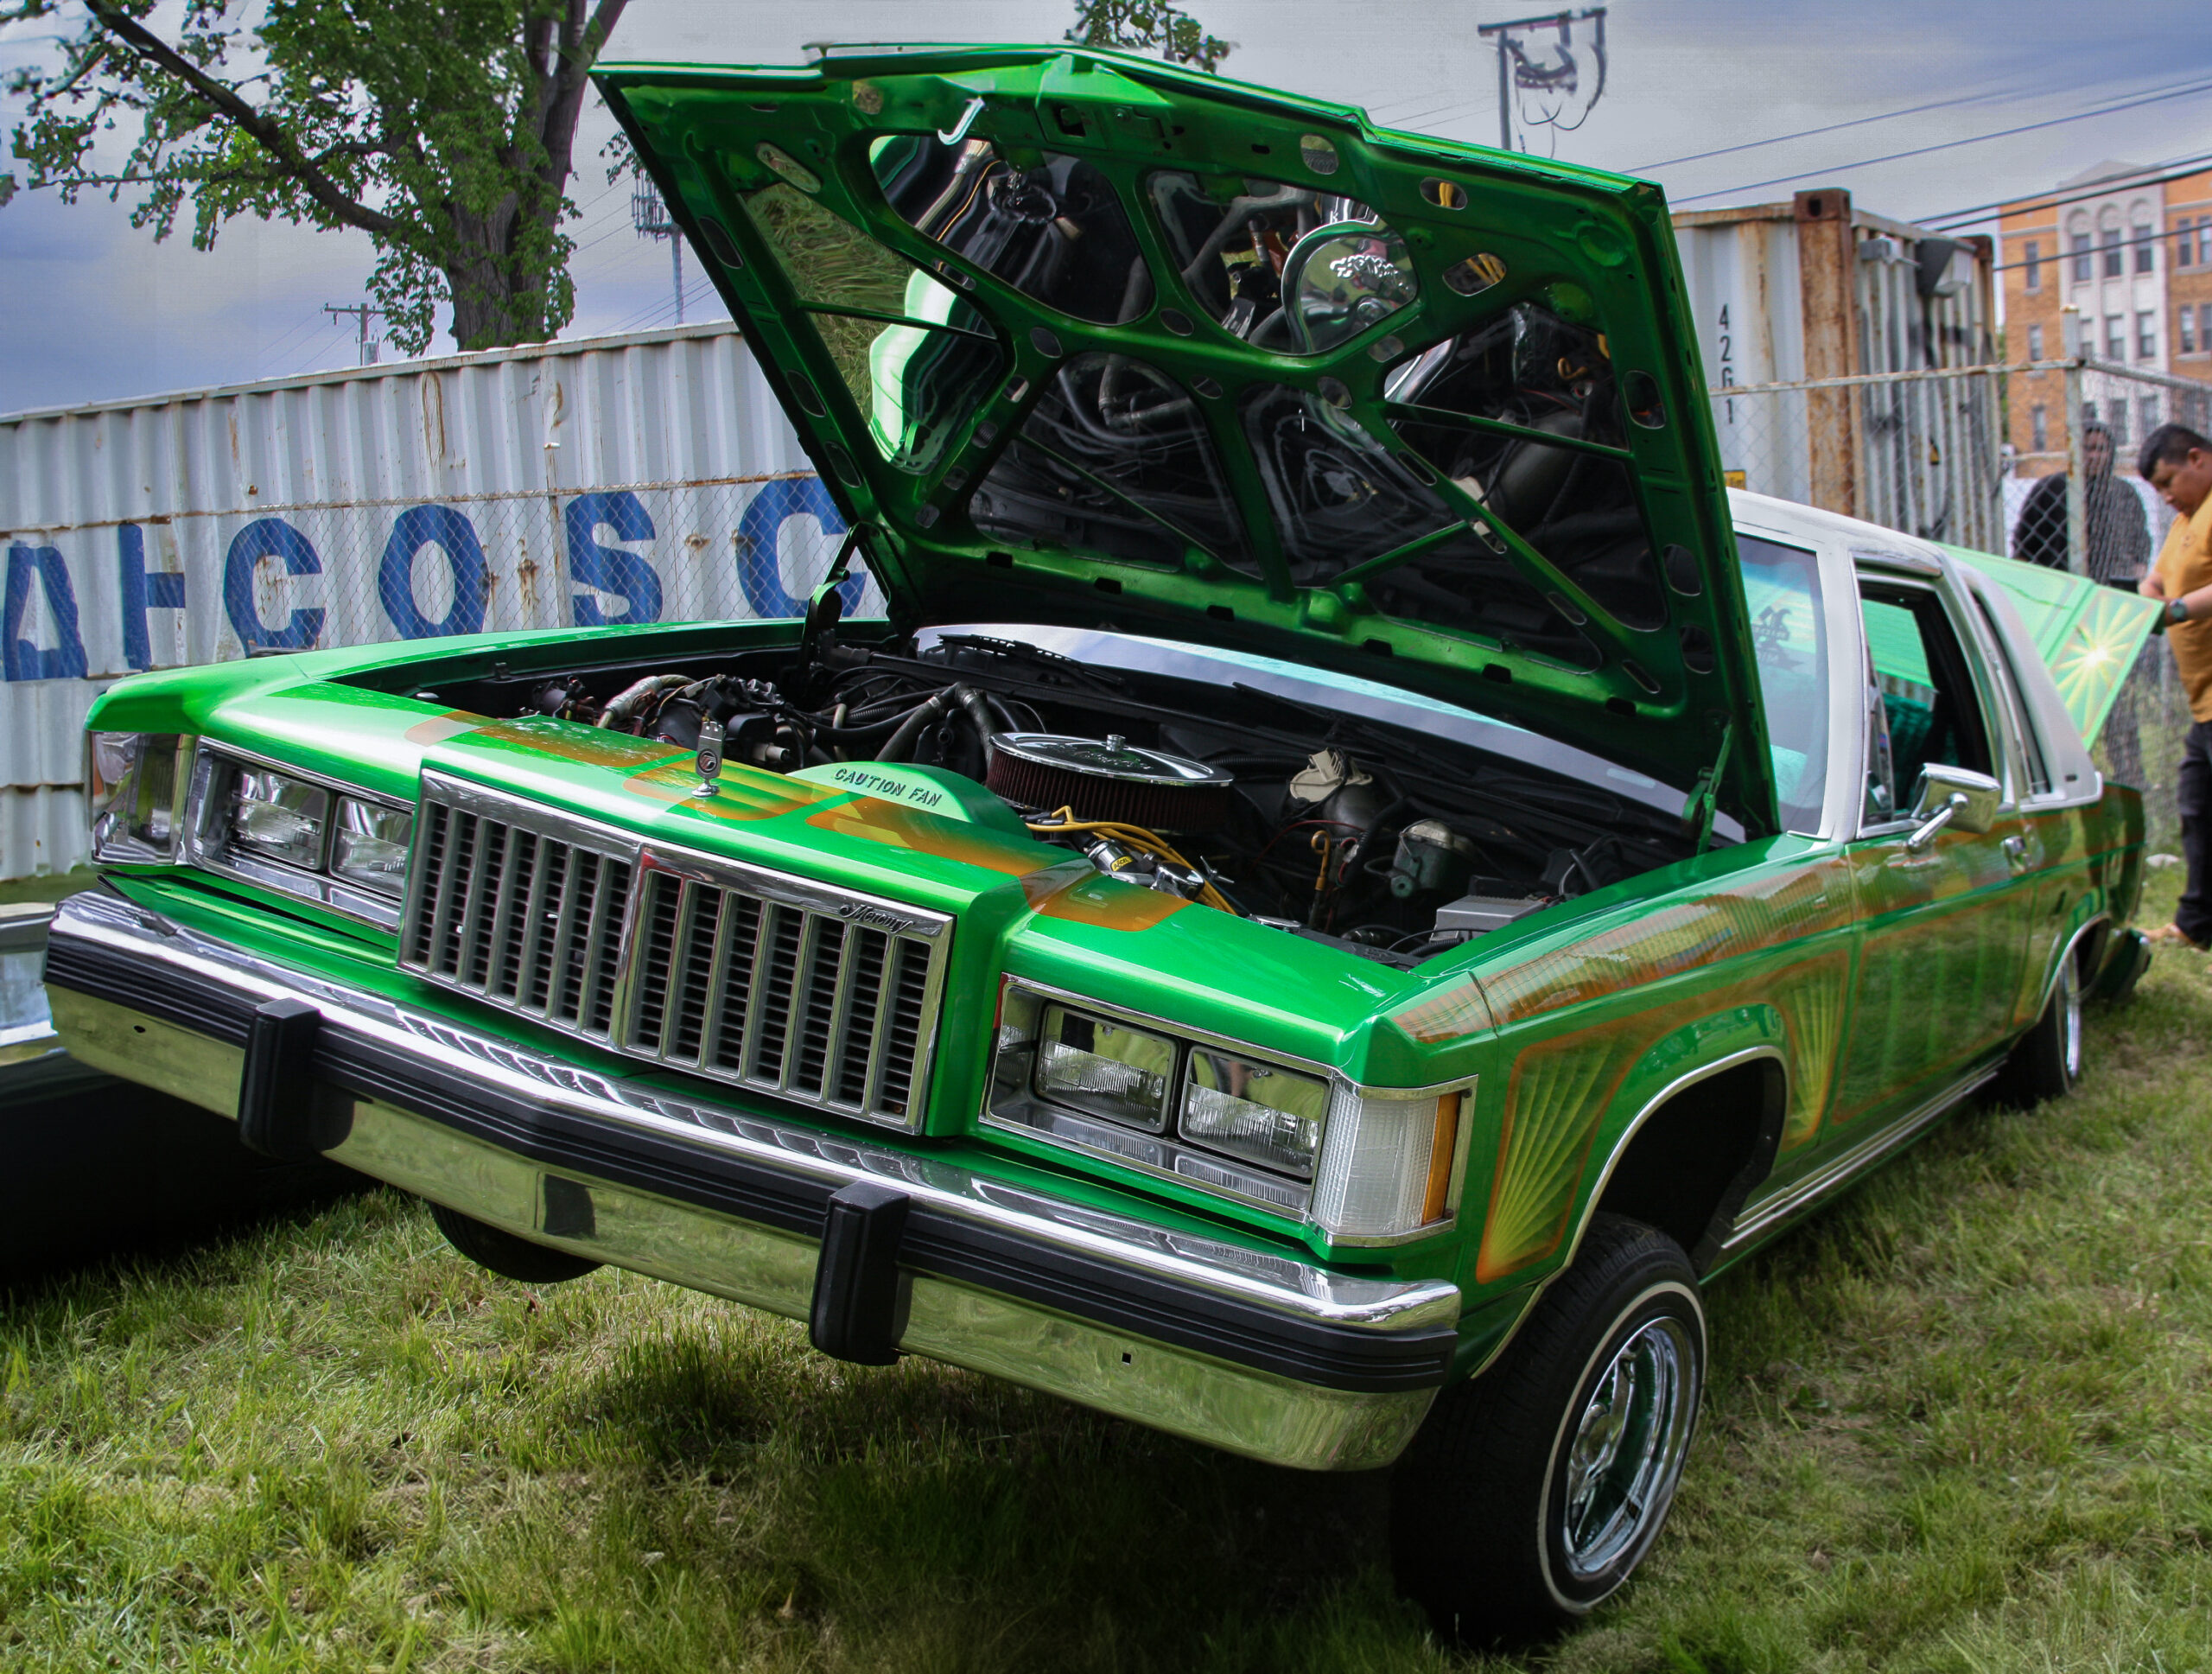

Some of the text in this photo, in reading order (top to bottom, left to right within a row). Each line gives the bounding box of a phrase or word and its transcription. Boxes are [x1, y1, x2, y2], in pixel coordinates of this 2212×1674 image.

[834, 767, 943, 807] CAUTION FAN
[839, 904, 916, 934] Mercury
